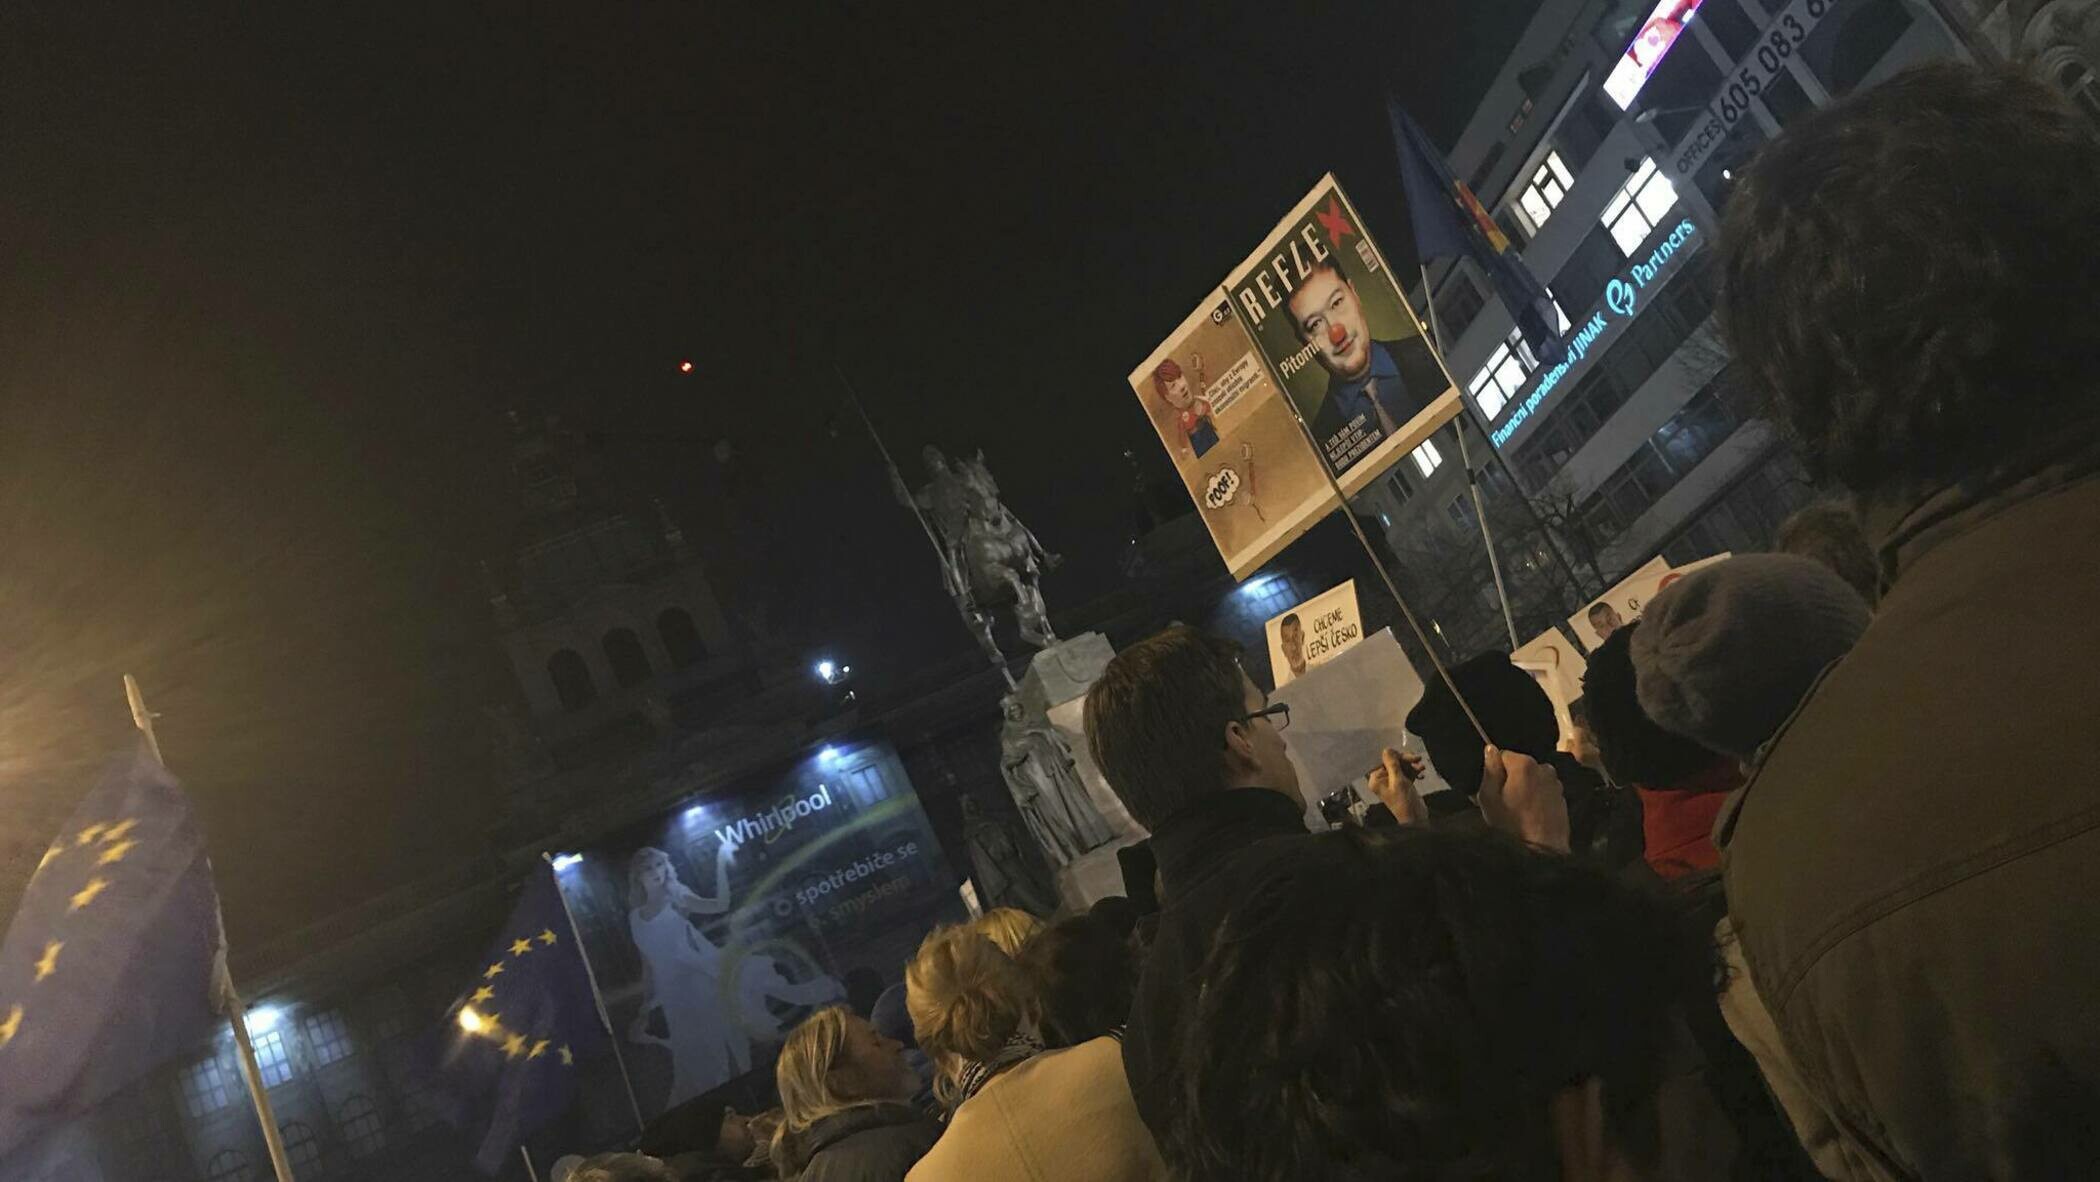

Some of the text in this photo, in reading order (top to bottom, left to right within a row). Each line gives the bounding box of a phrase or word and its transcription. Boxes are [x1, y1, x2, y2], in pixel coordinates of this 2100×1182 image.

[1676, 118, 1721, 174] OFFICES
[1719, 67, 1761, 124] 605
[1758, 14, 1805, 74] 083
[1239, 195, 1356, 325] REFLEX
[1630, 218, 1696, 289] Partners
[1525, 344, 1577, 416] poradensví
[1573, 310, 1608, 360] JINAK
[1313, 607, 1343, 634] CHCEME
[714, 783, 833, 845] Whirlpool
[795, 840, 919, 906] spotřebiče se
